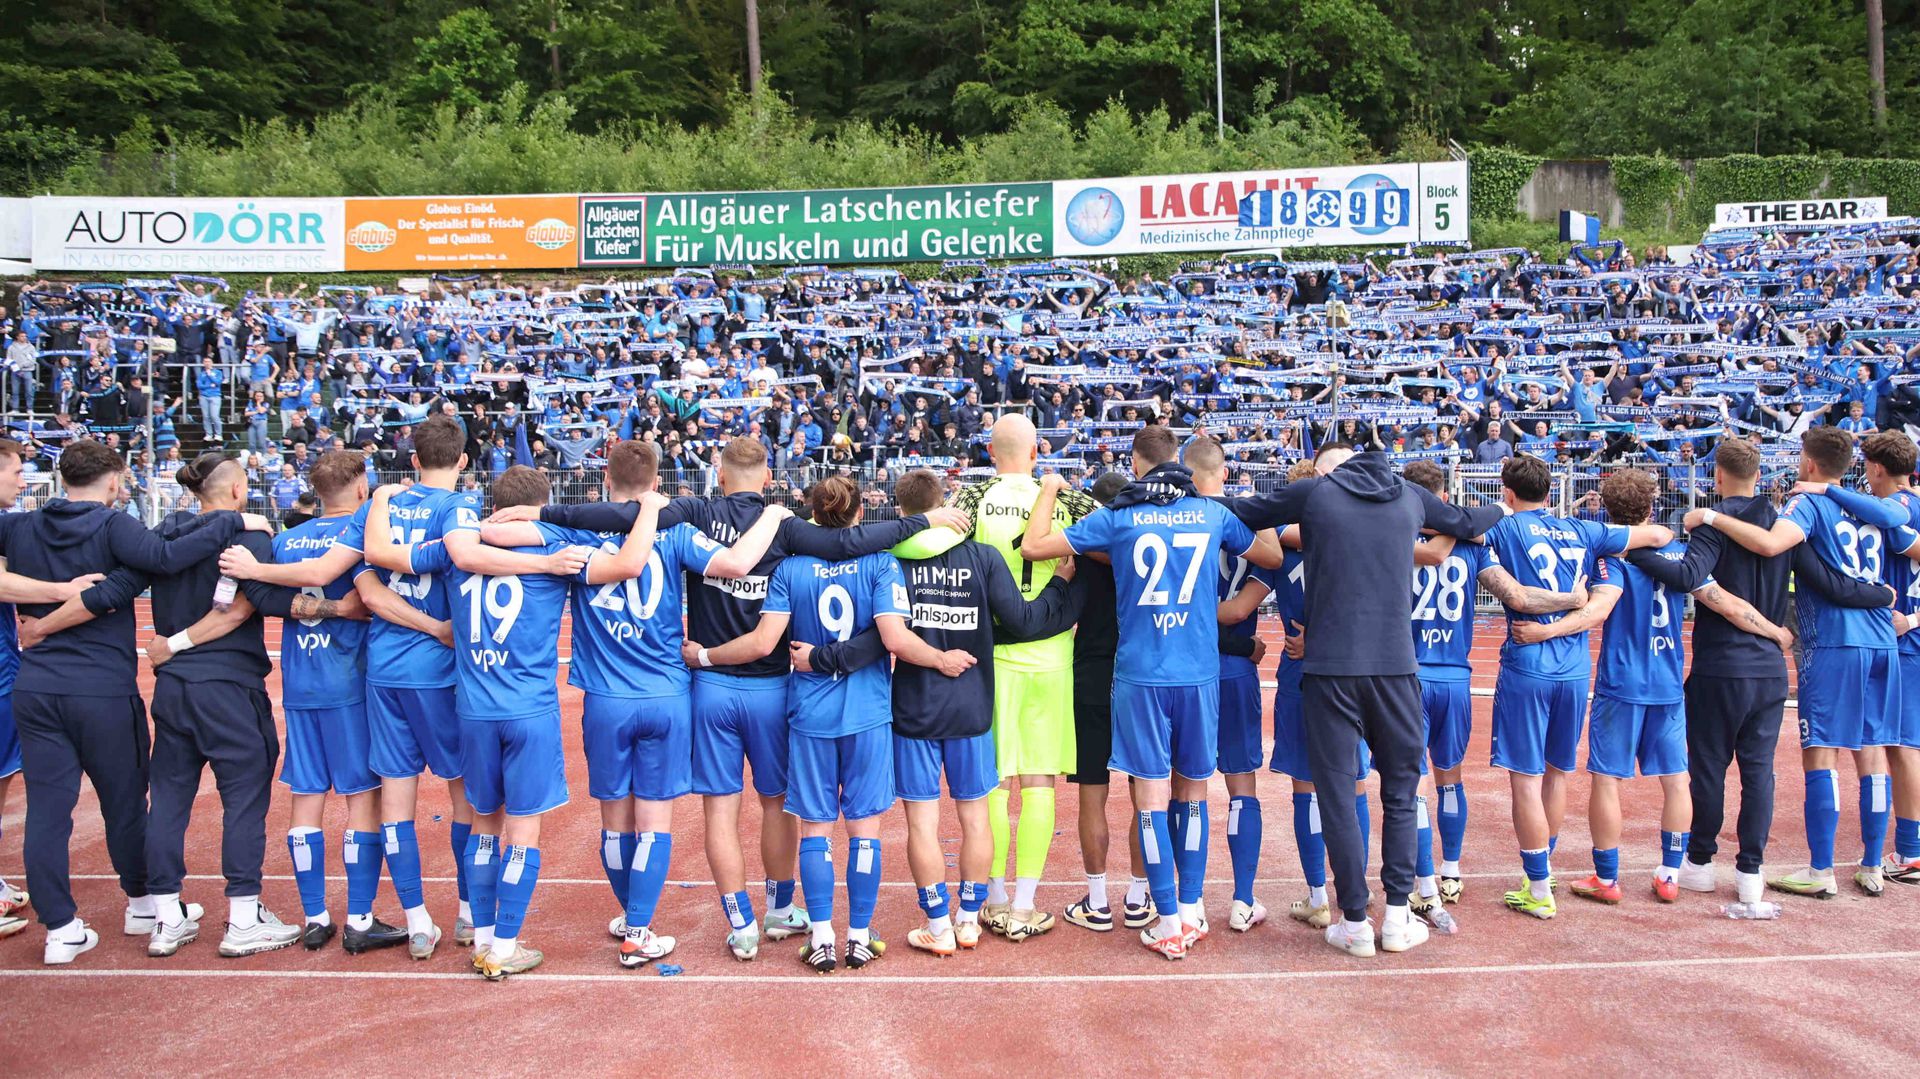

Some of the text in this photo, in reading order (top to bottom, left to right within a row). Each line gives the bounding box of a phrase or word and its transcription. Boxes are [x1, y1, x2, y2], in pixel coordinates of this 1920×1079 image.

[1426, 184, 1459, 199] Block
[425, 203, 461, 215] Globus
[586, 206, 640, 225] Allgäuer
[655, 189, 1040, 234] Allgäuer Latschenkiefer
[1434, 202, 1450, 231] 5
[1742, 201, 1859, 222] THE BAR
[65, 202, 325, 244] AUTO DÖRR
[398, 217, 525, 231] Der Spezialist für Frische
[586, 222, 640, 239] Latschen
[428, 234, 448, 245] und
[655, 226, 1043, 263] Für Muskeln und Gelenke
[1139, 228, 1230, 245] Medizinische
[1132, 509, 1206, 528] Kalajdžić
[1834, 520, 1882, 583] 33
[1132, 532, 1211, 606] 27
[1527, 542, 1587, 593] 37
[588, 540, 664, 620] 20
[1411, 555, 1469, 622] 28
[944, 590, 972, 599] CMPANY
[459, 574, 525, 646] 19
[818, 583, 855, 642] 9
[913, 605, 976, 627] uhlsport
[1152, 611, 1189, 636] vpv
[296, 633, 331, 657] vpv
[1421, 628, 1454, 649] vpv
[470, 649, 510, 673] vpv
